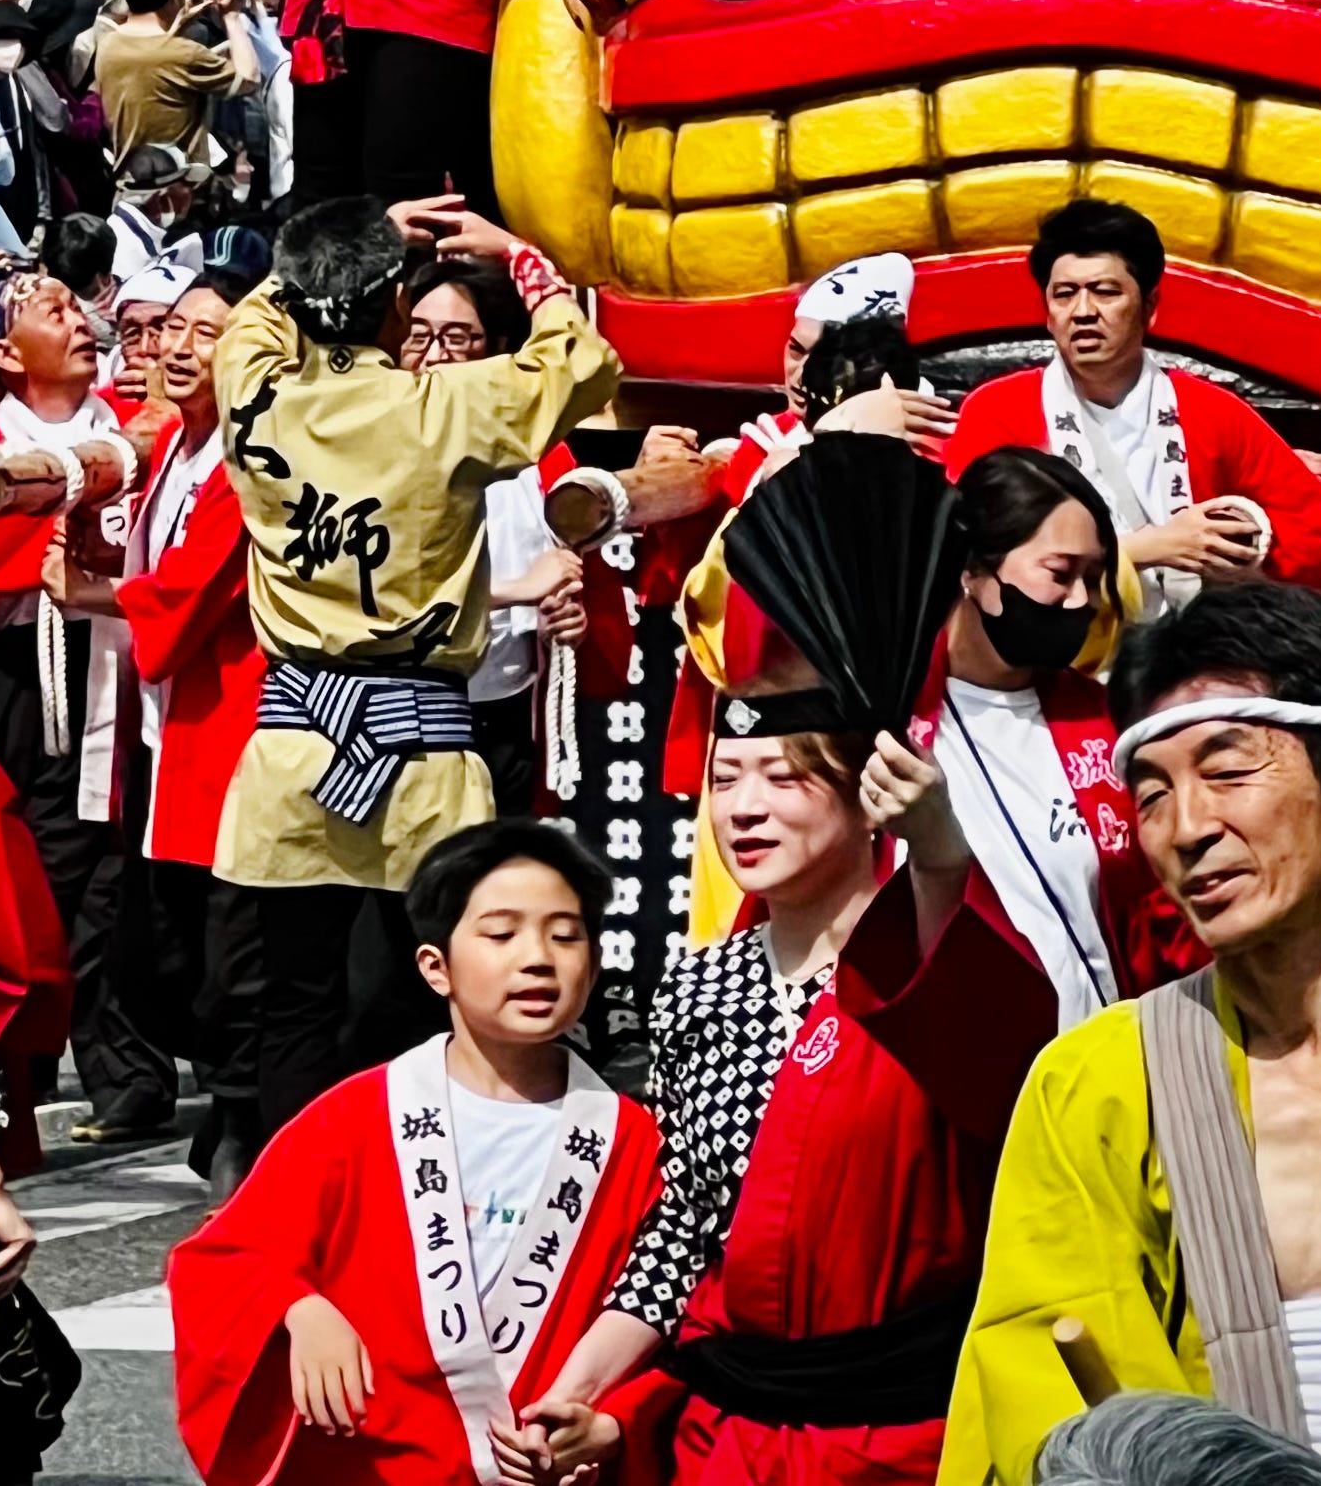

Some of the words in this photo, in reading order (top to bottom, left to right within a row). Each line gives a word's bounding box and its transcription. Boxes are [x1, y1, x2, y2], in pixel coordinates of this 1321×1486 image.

[401, 1107, 467, 1344] 城島まつり
[492, 1125, 607, 1355] 城島まつり
